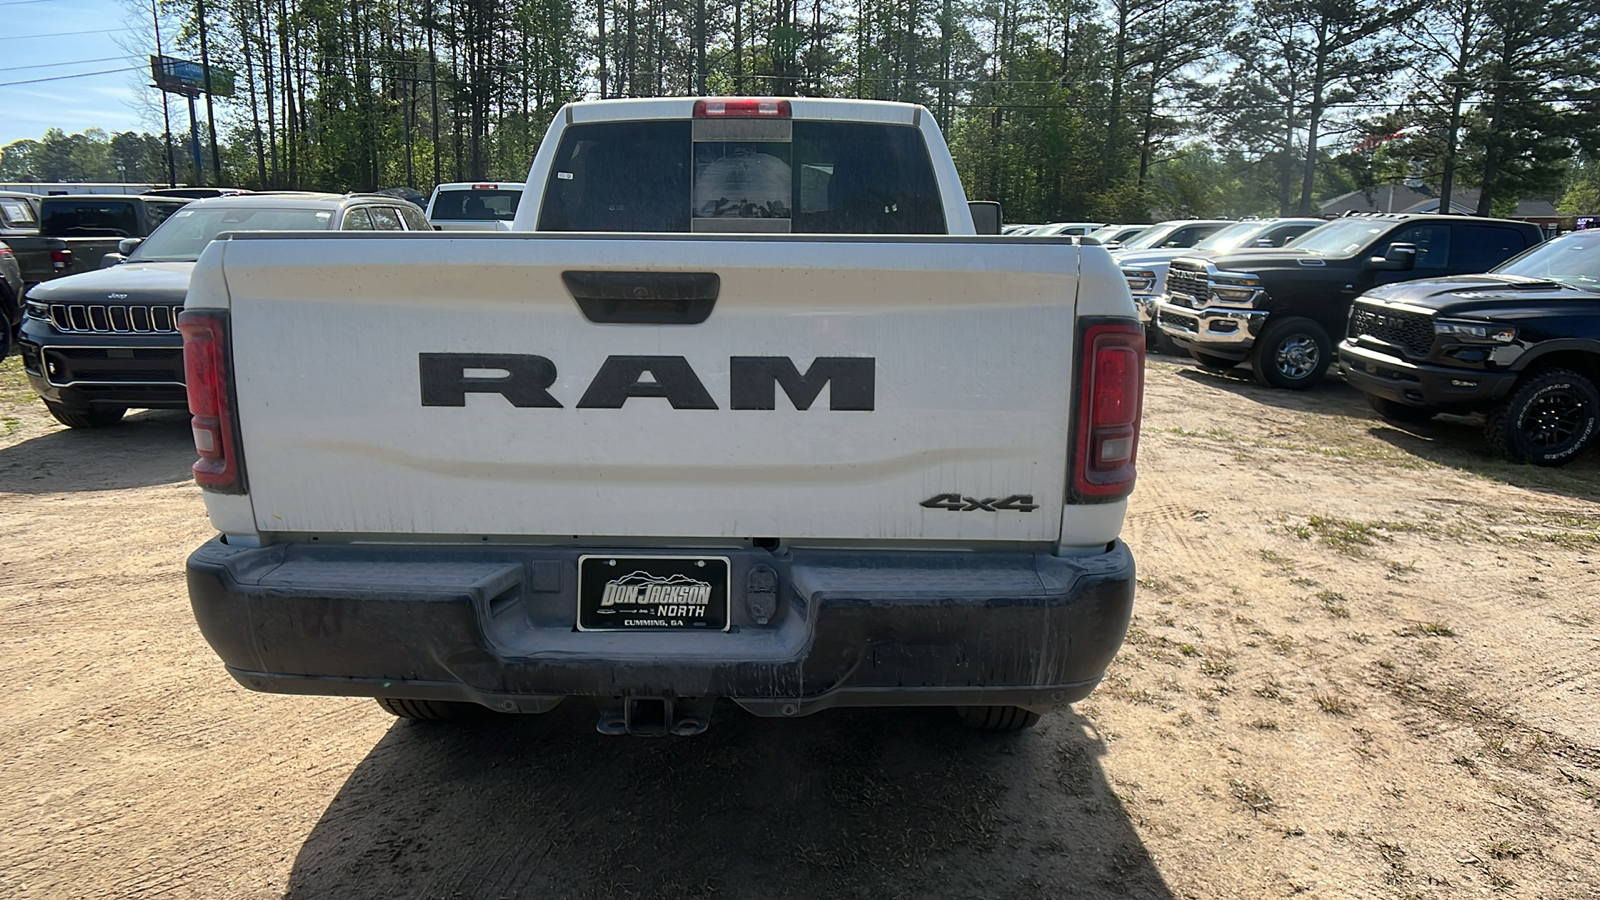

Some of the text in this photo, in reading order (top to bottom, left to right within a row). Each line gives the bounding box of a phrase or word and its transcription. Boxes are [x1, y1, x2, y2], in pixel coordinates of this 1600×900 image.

[419, 352, 876, 411] RAM
[919, 493, 1040, 512] 4x4
[600, 583, 712, 607] DON JACKSON
[657, 605, 705, 617] NORTH
[624, 619, 668, 627] CUMMING,
